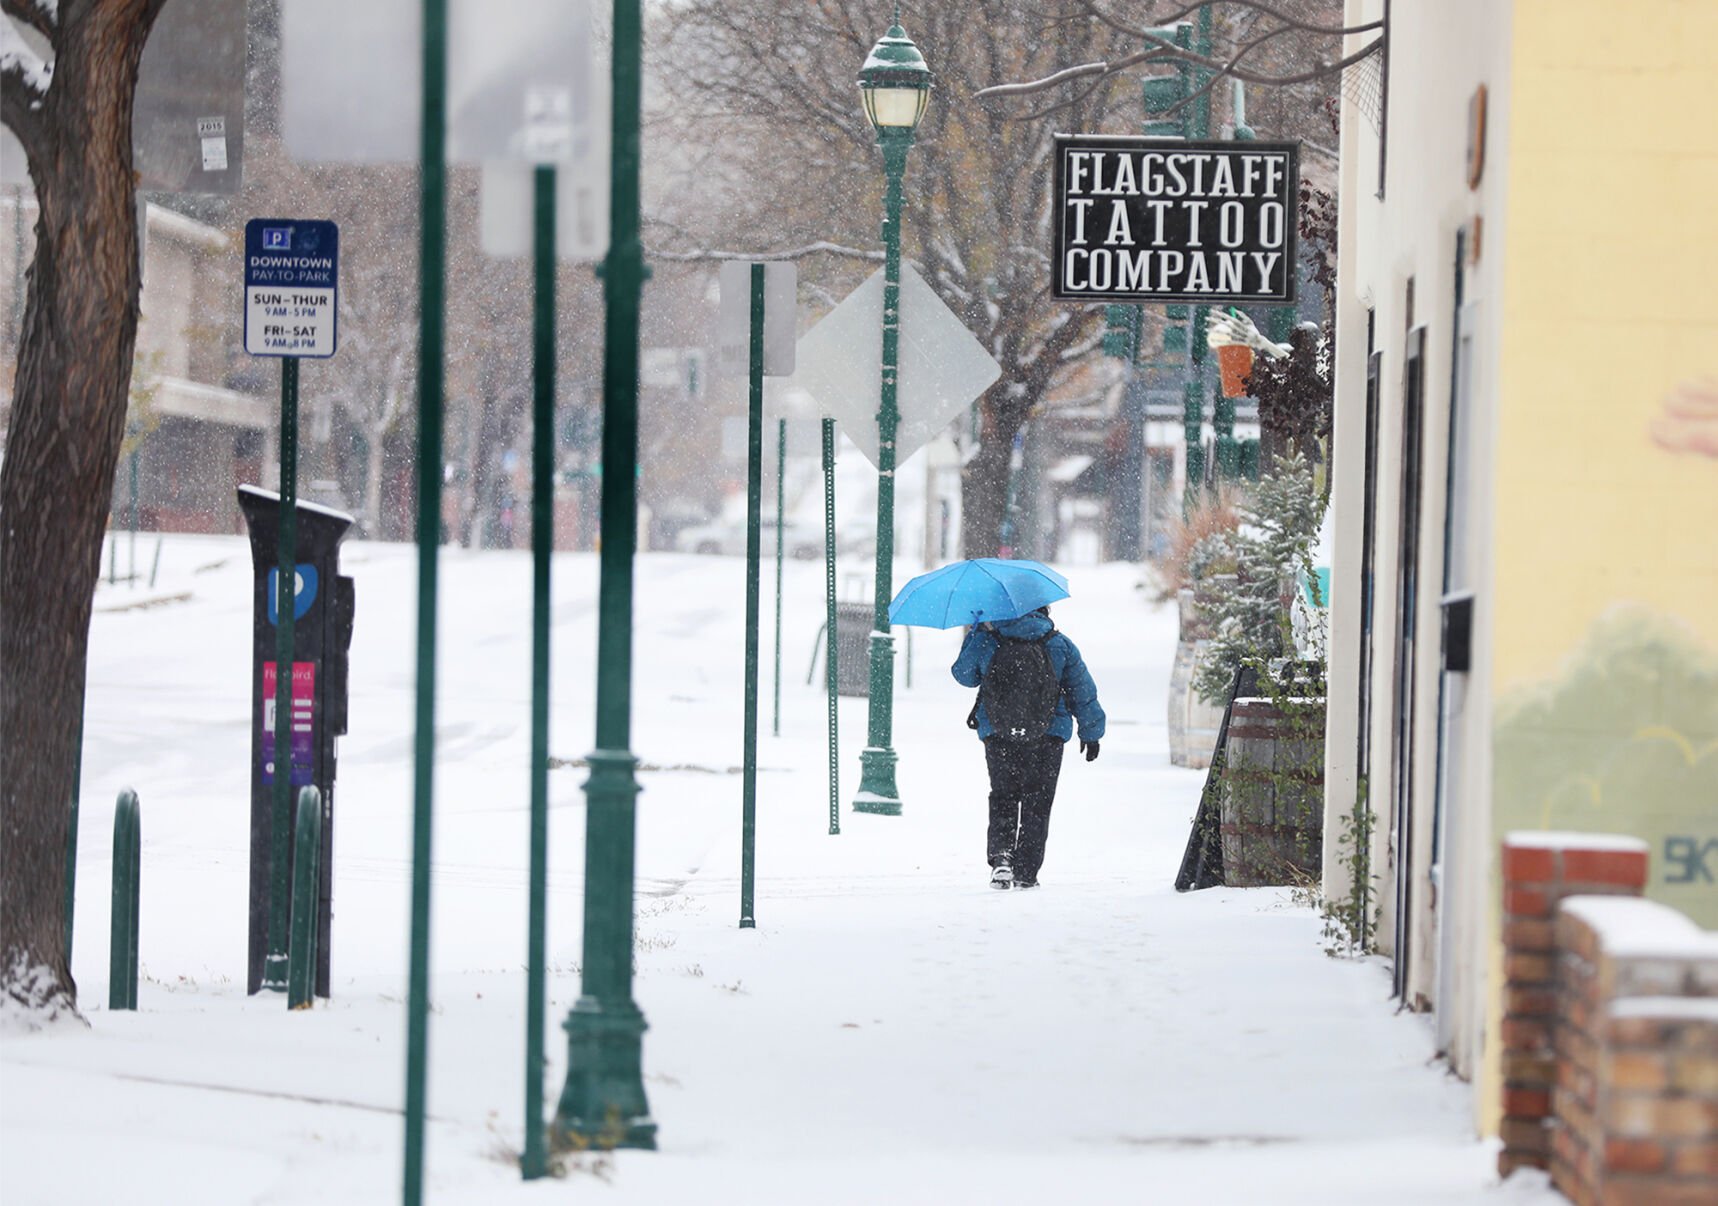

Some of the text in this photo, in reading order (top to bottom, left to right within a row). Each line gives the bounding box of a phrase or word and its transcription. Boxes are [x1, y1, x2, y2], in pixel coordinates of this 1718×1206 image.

[1067, 152, 1285, 197] FLAGSTAFF
[1067, 198, 1285, 249] TATTOO
[250, 257, 332, 269] DOWNTOWN
[1066, 248, 1282, 293] COMPANY
[265, 306, 271, 316] 9
[272, 306, 287, 317] AM
[294, 307, 300, 317] 5
[302, 307, 316, 317] PM
[264, 338, 271, 348] 9
[272, 338, 287, 348] AM
[301, 339, 316, 348] PM
